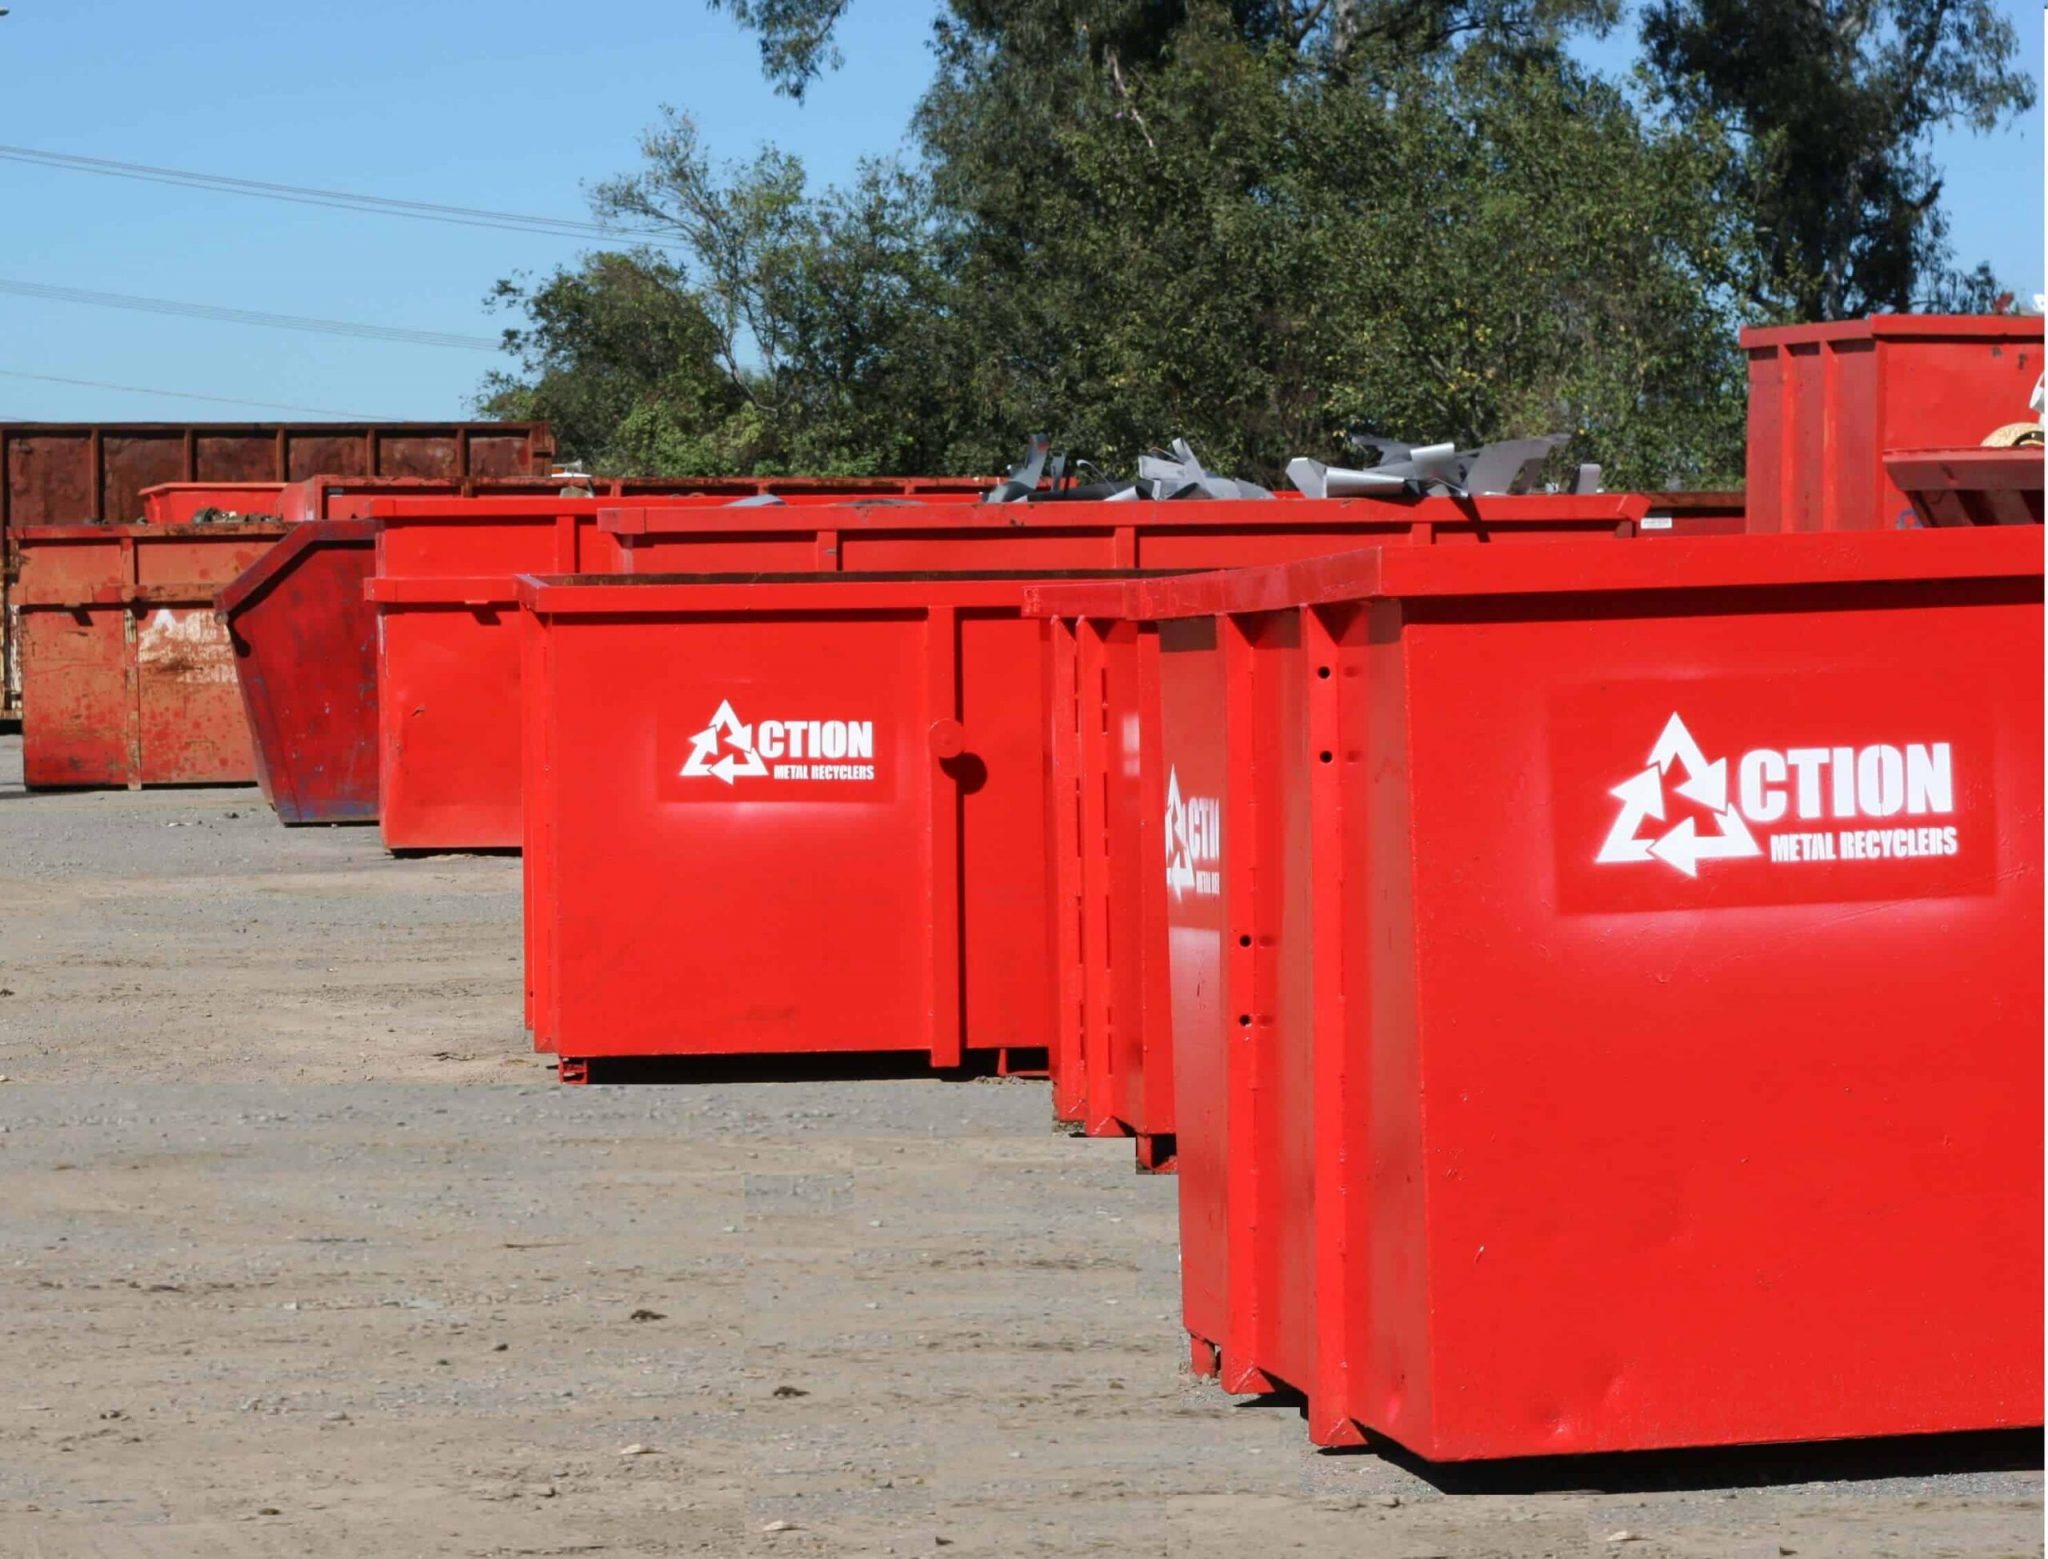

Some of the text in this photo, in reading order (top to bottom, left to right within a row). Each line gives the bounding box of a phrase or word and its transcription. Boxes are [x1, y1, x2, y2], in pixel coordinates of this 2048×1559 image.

[774, 764, 875, 780] METAL RECYCLERS
[1770, 826, 1958, 863] METAL RECYCLERS
